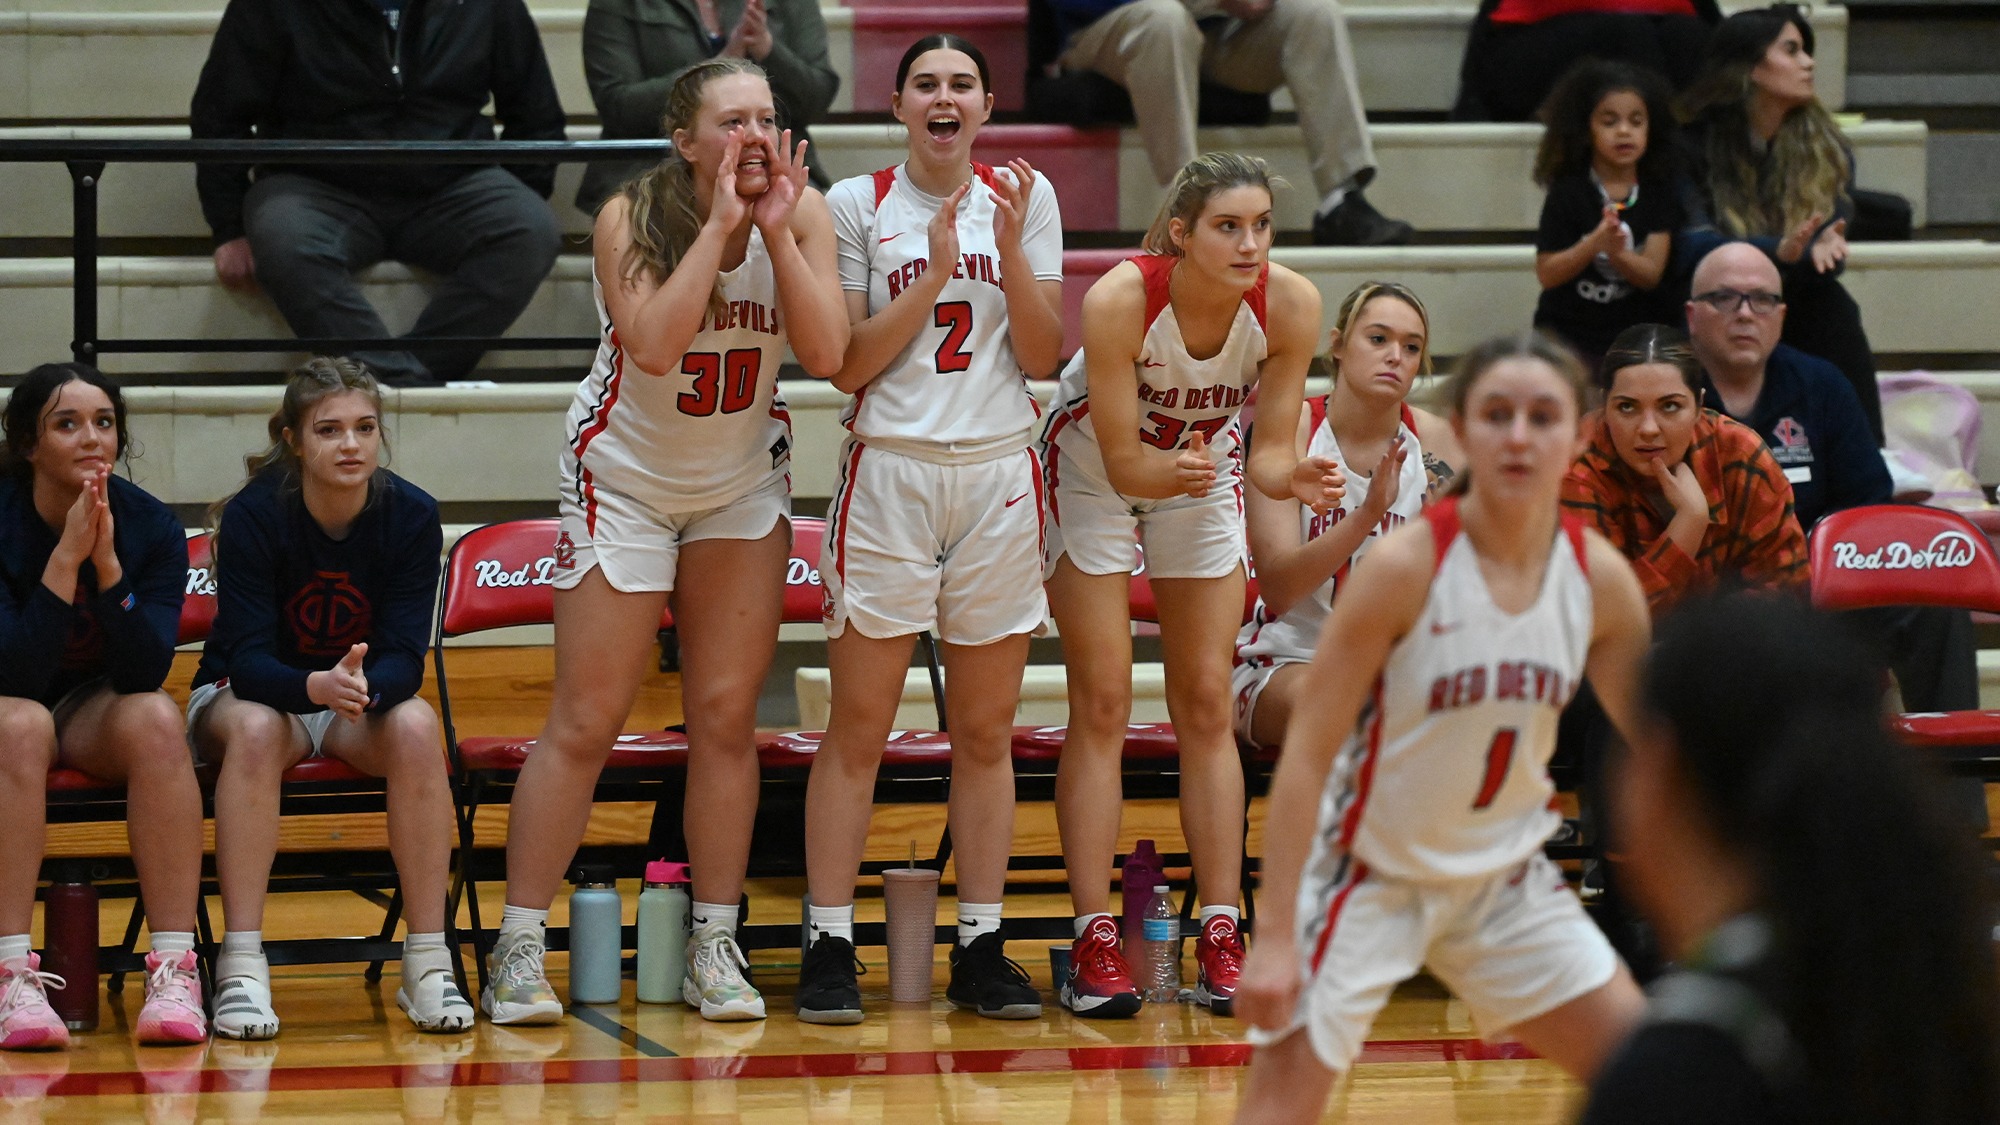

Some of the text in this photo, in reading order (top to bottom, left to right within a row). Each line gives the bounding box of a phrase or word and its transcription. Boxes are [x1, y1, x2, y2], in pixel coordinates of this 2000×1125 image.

[887, 253, 1006, 302] RED EVIL
[714, 300, 779, 335] DEVILS
[934, 300, 973, 374] 2
[676, 347, 761, 417] 30
[1138, 382, 1250, 409] RED DEVILS
[1308, 507, 1347, 542] RED
[1832, 530, 1976, 570] Red Devils
[185, 567, 218, 596] Re
[474, 559, 530, 588] Red
[1428, 664, 1487, 714] RED
[1470, 724, 1521, 812] 1
